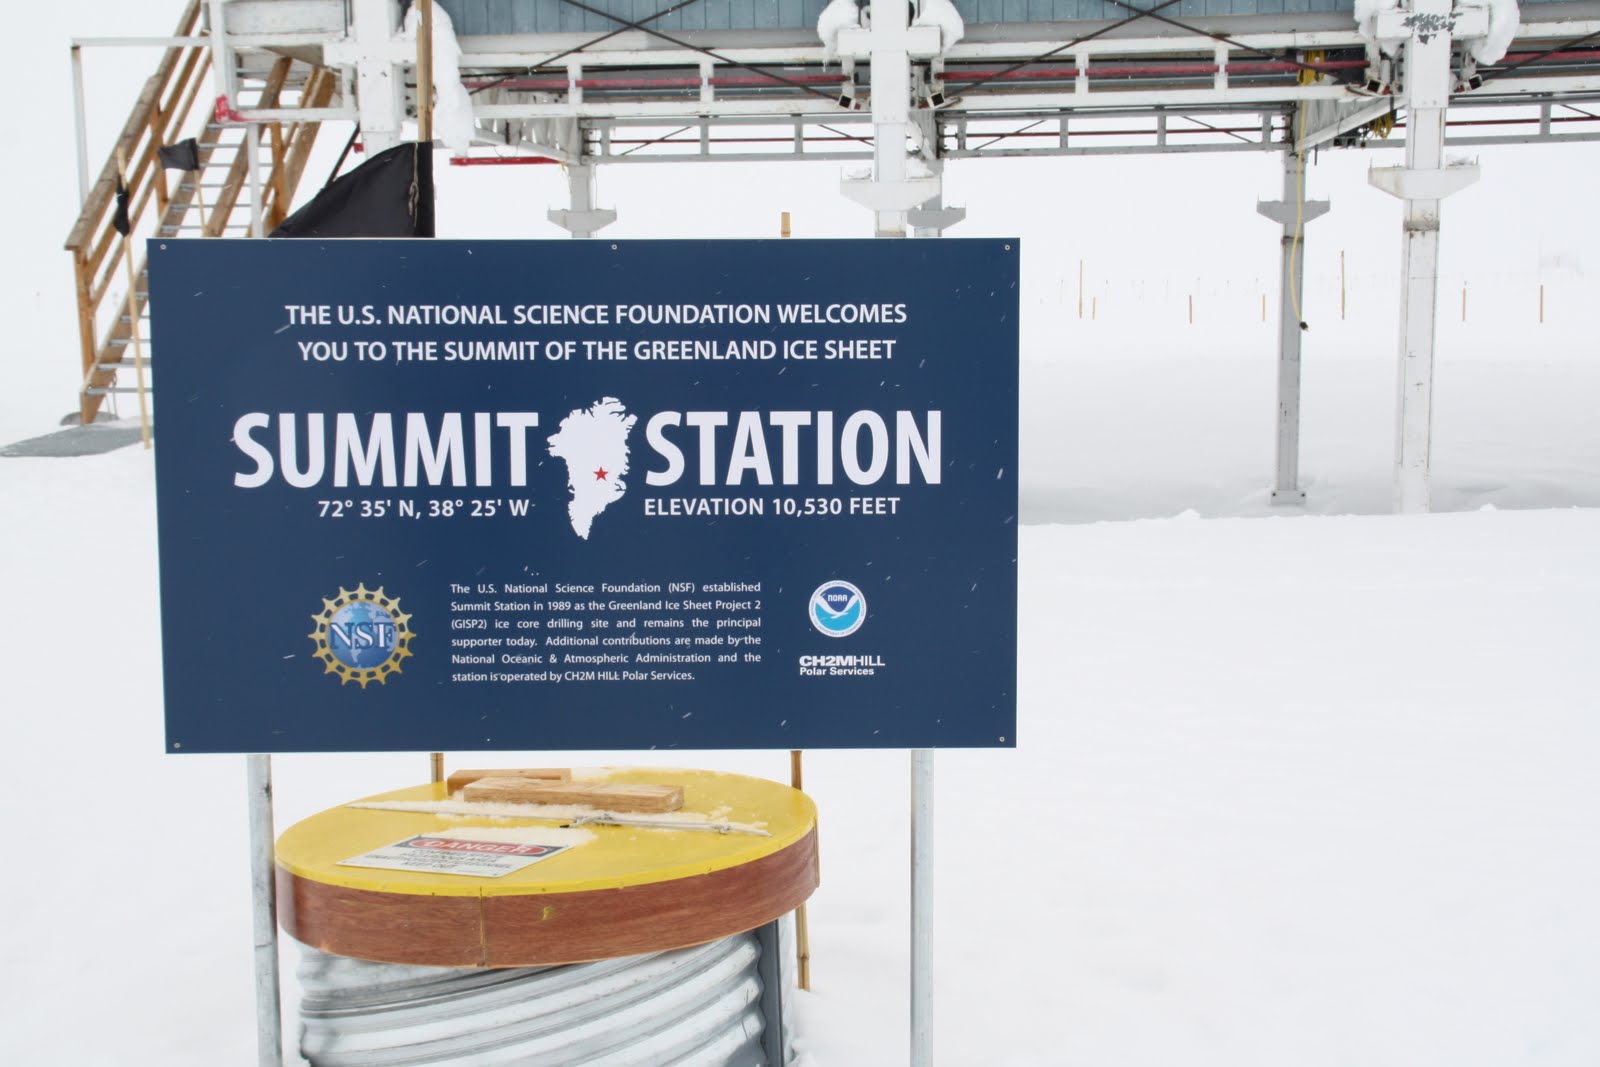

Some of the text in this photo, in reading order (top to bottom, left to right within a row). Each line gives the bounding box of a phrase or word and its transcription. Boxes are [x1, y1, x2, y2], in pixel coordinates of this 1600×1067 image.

[284, 303, 907, 325] THE U.S. NATIONAL SCIENCE FOUNDATION WELCOMES
[297, 339, 897, 361] YOU TO THE SUMMIT OF THE GREENLAND ICE SHEET
[233, 410, 942, 489] SUMMIT STATION
[318, 499, 530, 520] 72° 35' N, 38° 25' W
[644, 497, 901, 518] ELEVATION 10,530 FEET
[450, 582, 761, 594] The U.S. National Science Foundation (NSF) established
[827, 594, 848, 602] NOAA
[451, 599, 761, 612] Summit Station in 1989 as the Greenland Ice Sheet Project 2
[451, 617, 761, 631] (GISP2) ice core drilling site and remains the principal
[329, 621, 397, 649] NSF
[452, 635, 762, 648] supporter today. Additional contributions are made by the
[452, 652, 762, 665] National Oceanic & Atmospheric Administration and the
[452, 670, 695, 683] station is operated by CH2M HILL Polar Services.
[799, 666, 875, 676] Polar Services
[424, 840, 531, 853] DANGER
